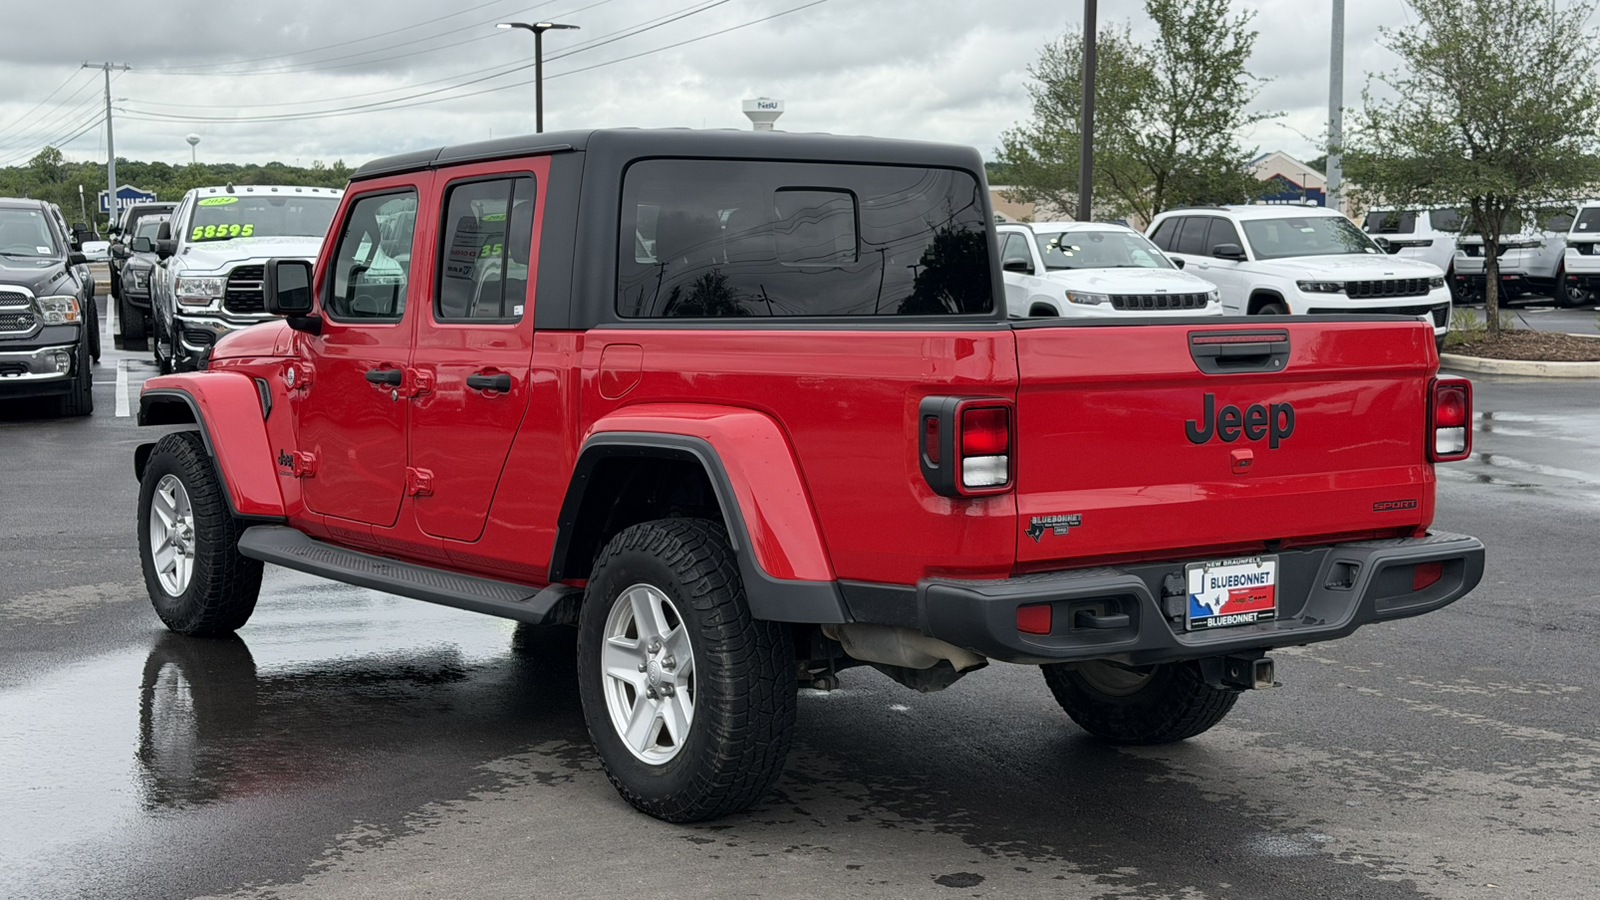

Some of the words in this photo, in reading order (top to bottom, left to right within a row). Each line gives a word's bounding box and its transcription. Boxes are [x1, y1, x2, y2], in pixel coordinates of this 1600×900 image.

[204, 197, 232, 205] 2024
[191, 223, 254, 240] 58595
[1185, 393, 1295, 450] Jeep
[1373, 499, 1417, 510] SPORT
[1032, 513, 1082, 524] BLUEBONNET
[1223, 557, 1261, 566] BRAUNFELS
[1210, 571, 1270, 589] BLUEBONNET
[1207, 612, 1259, 627] BLUEBONNET
